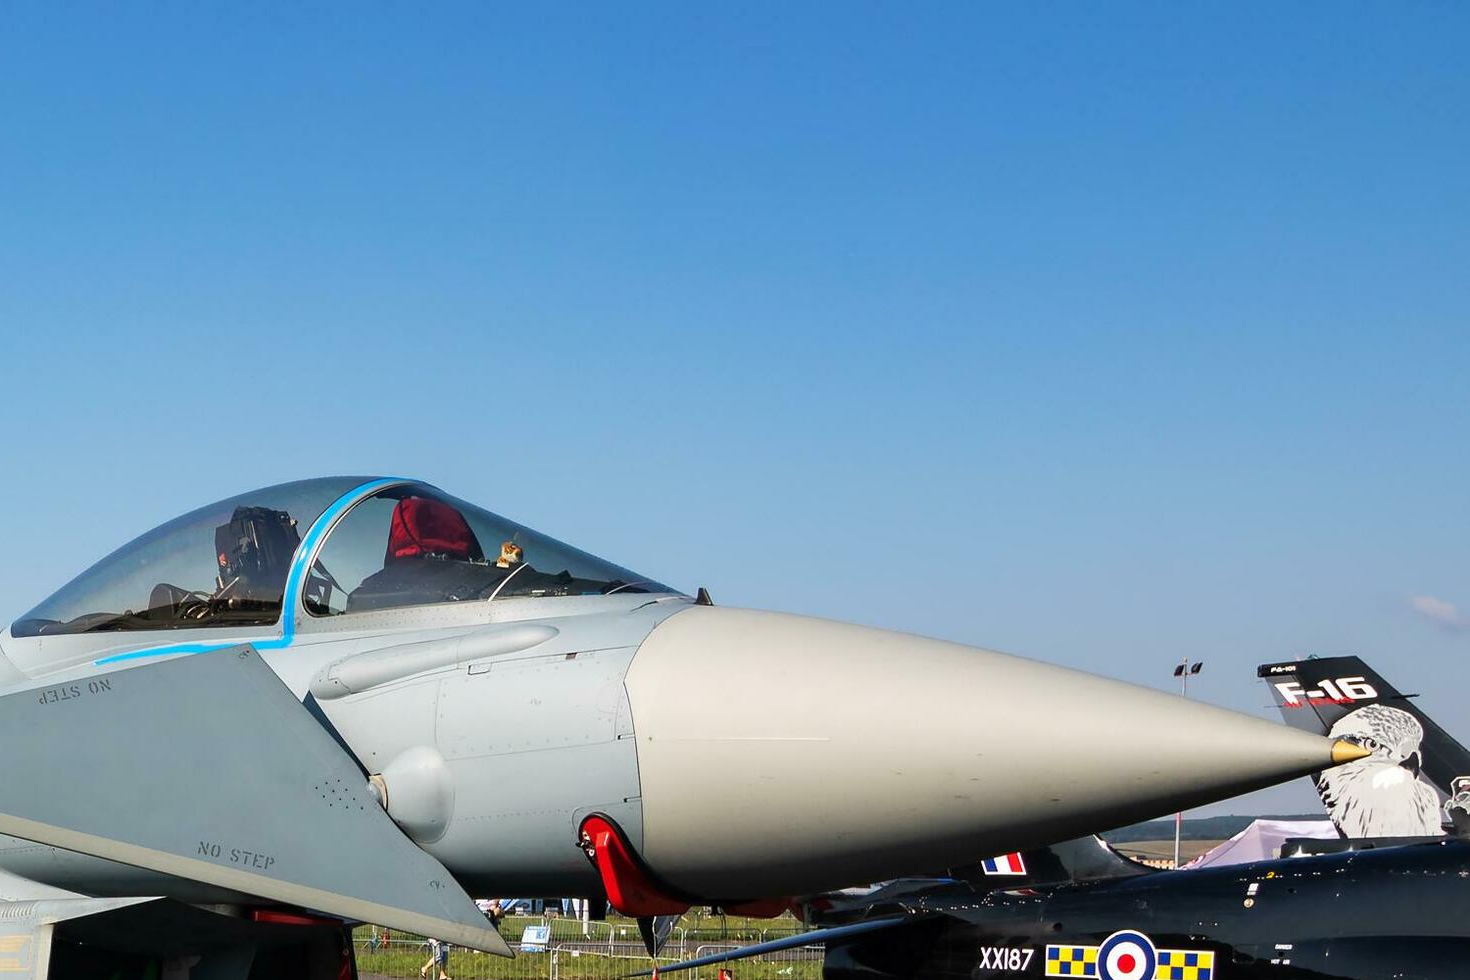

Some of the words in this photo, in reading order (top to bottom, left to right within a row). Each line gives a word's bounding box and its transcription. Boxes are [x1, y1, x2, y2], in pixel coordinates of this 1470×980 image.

[39, 686, 81, 704] STEP
[89, 679, 112, 694] NO
[1274, 677, 1378, 704] F-16
[198, 841, 221, 857] NO
[230, 848, 275, 869] STEP
[979, 946, 1034, 971] XX187
